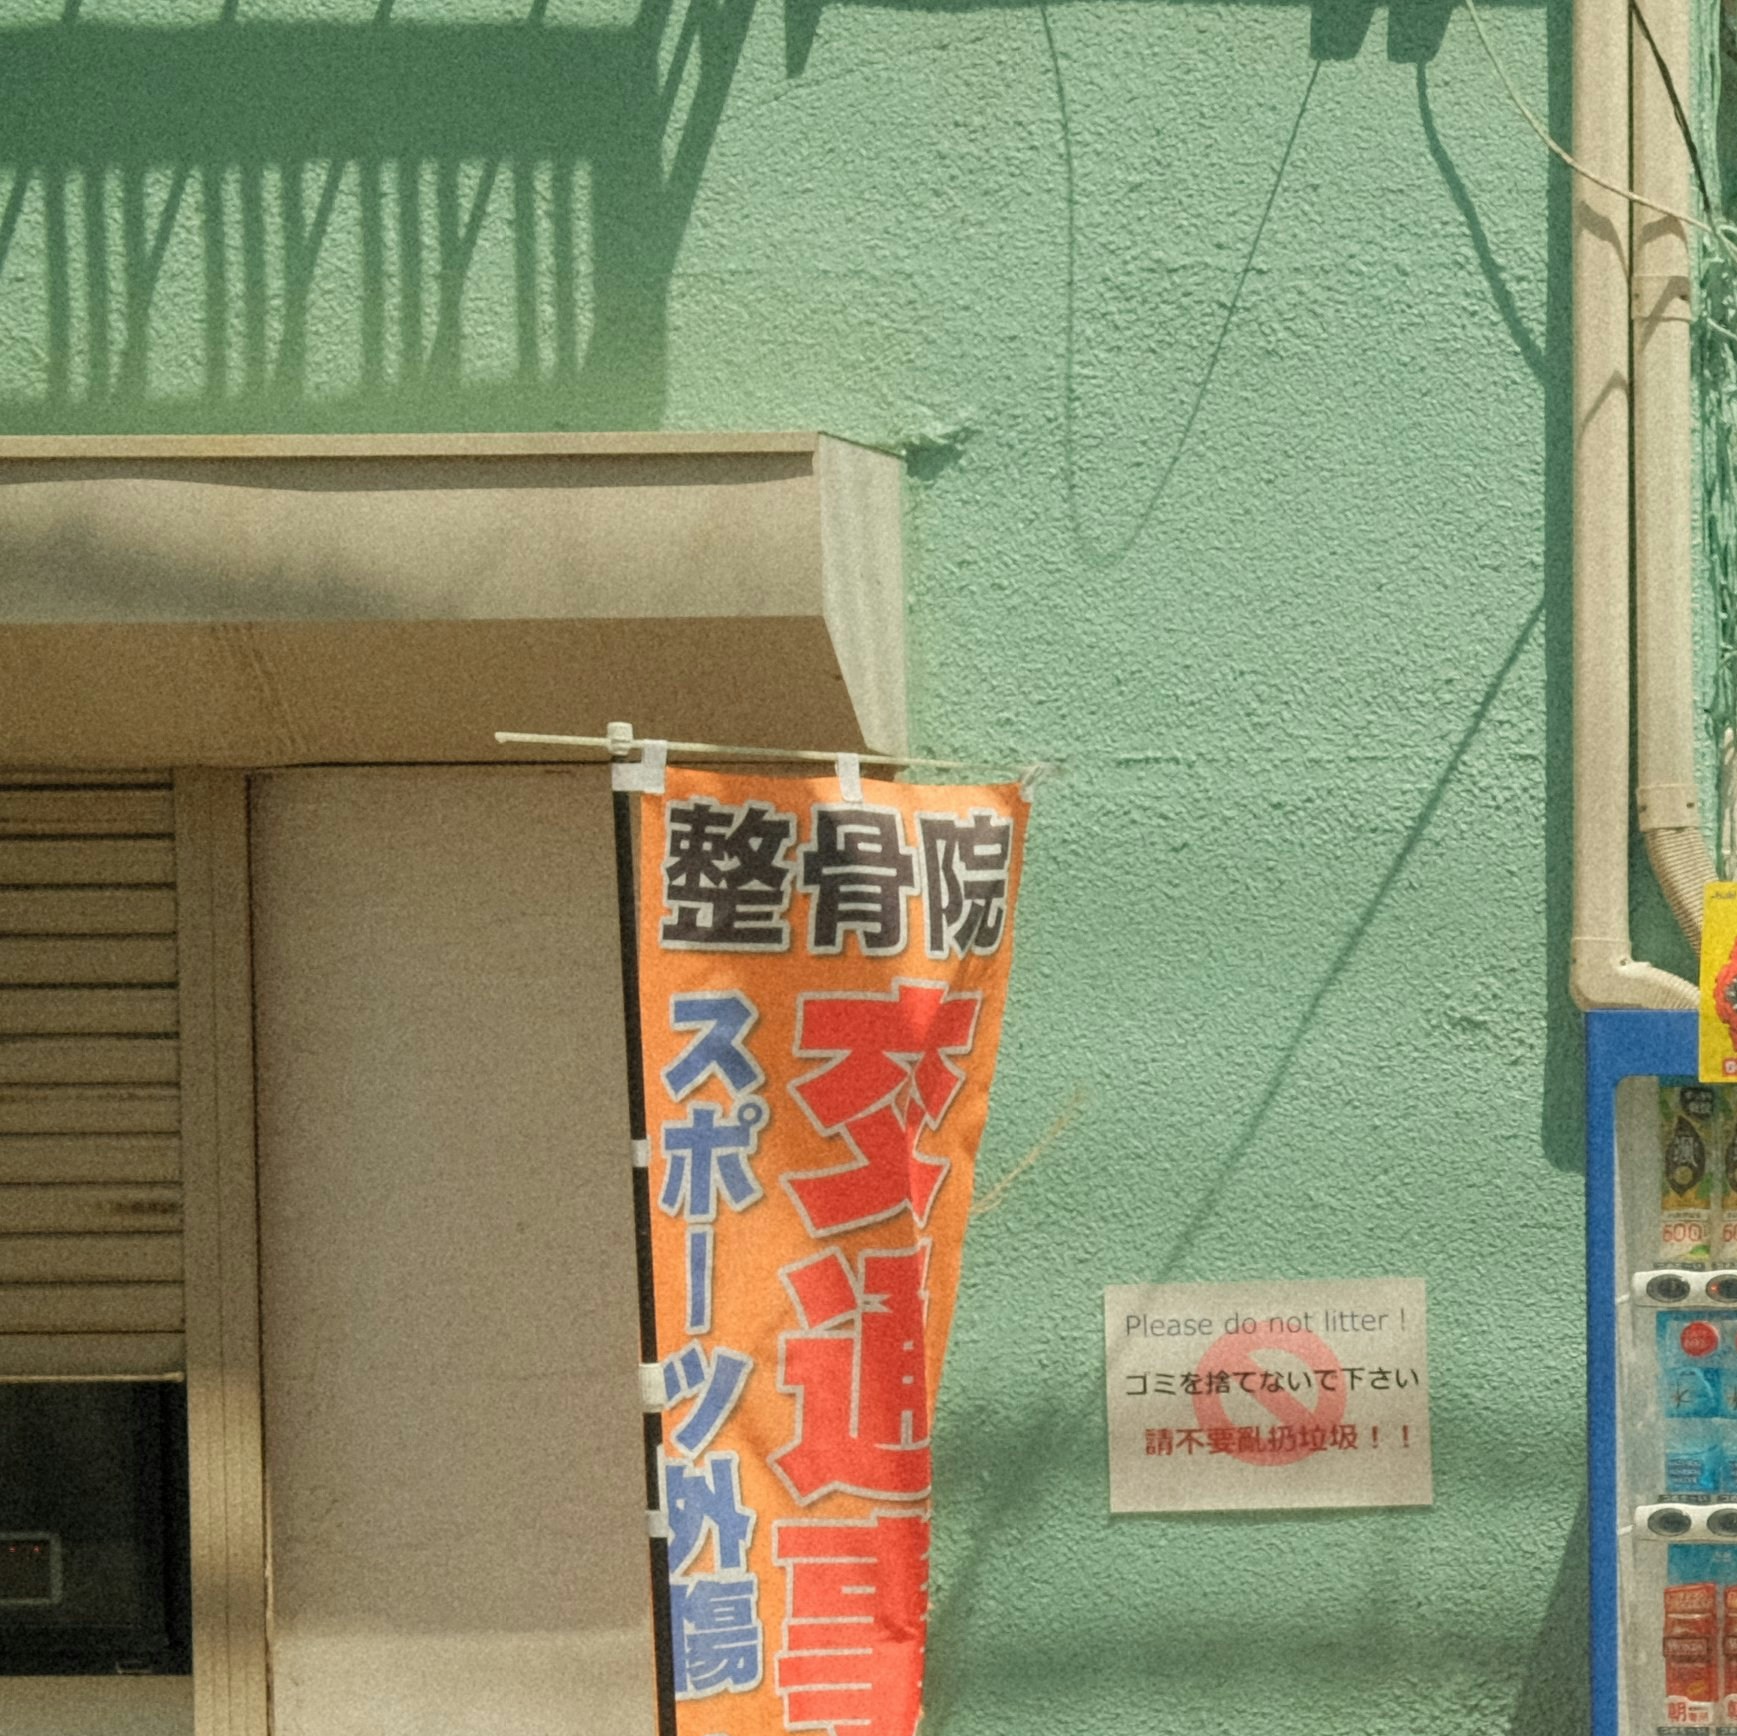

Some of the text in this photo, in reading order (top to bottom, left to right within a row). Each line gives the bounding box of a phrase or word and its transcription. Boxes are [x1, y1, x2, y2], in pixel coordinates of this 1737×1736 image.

[657, 797, 1013, 960] 整骨院
[1125, 1313, 1214, 1337] Please
[1224, 1311, 1256, 1335] do
[1268, 1310, 1314, 1335] not
[1324, 1308, 1389, 1333] litter
[1125, 1366, 1420, 1397] ゴミを捨てないで下さい
